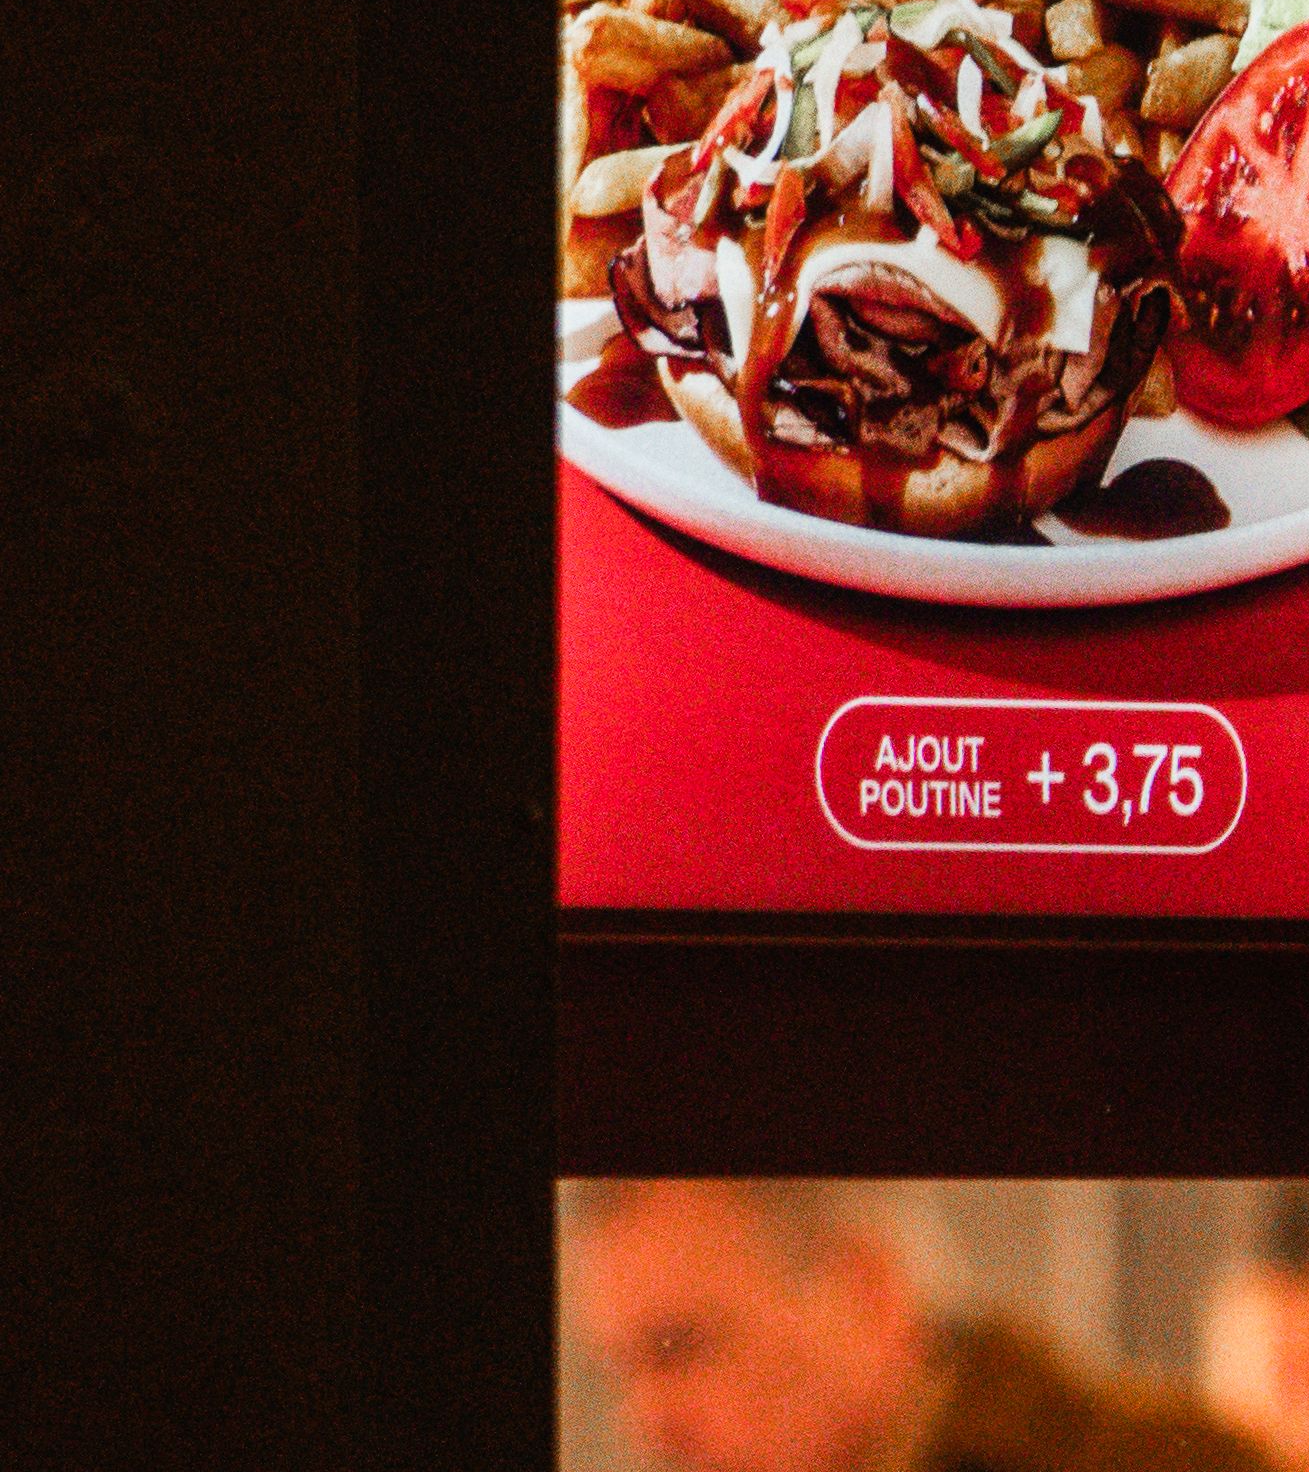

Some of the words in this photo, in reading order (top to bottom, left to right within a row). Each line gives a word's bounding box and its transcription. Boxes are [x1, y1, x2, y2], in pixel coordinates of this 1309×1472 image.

[874, 734, 985, 773] AJOUT
[859, 779, 1003, 819] POUTINE
[1081, 742, 1205, 827] 3,75
